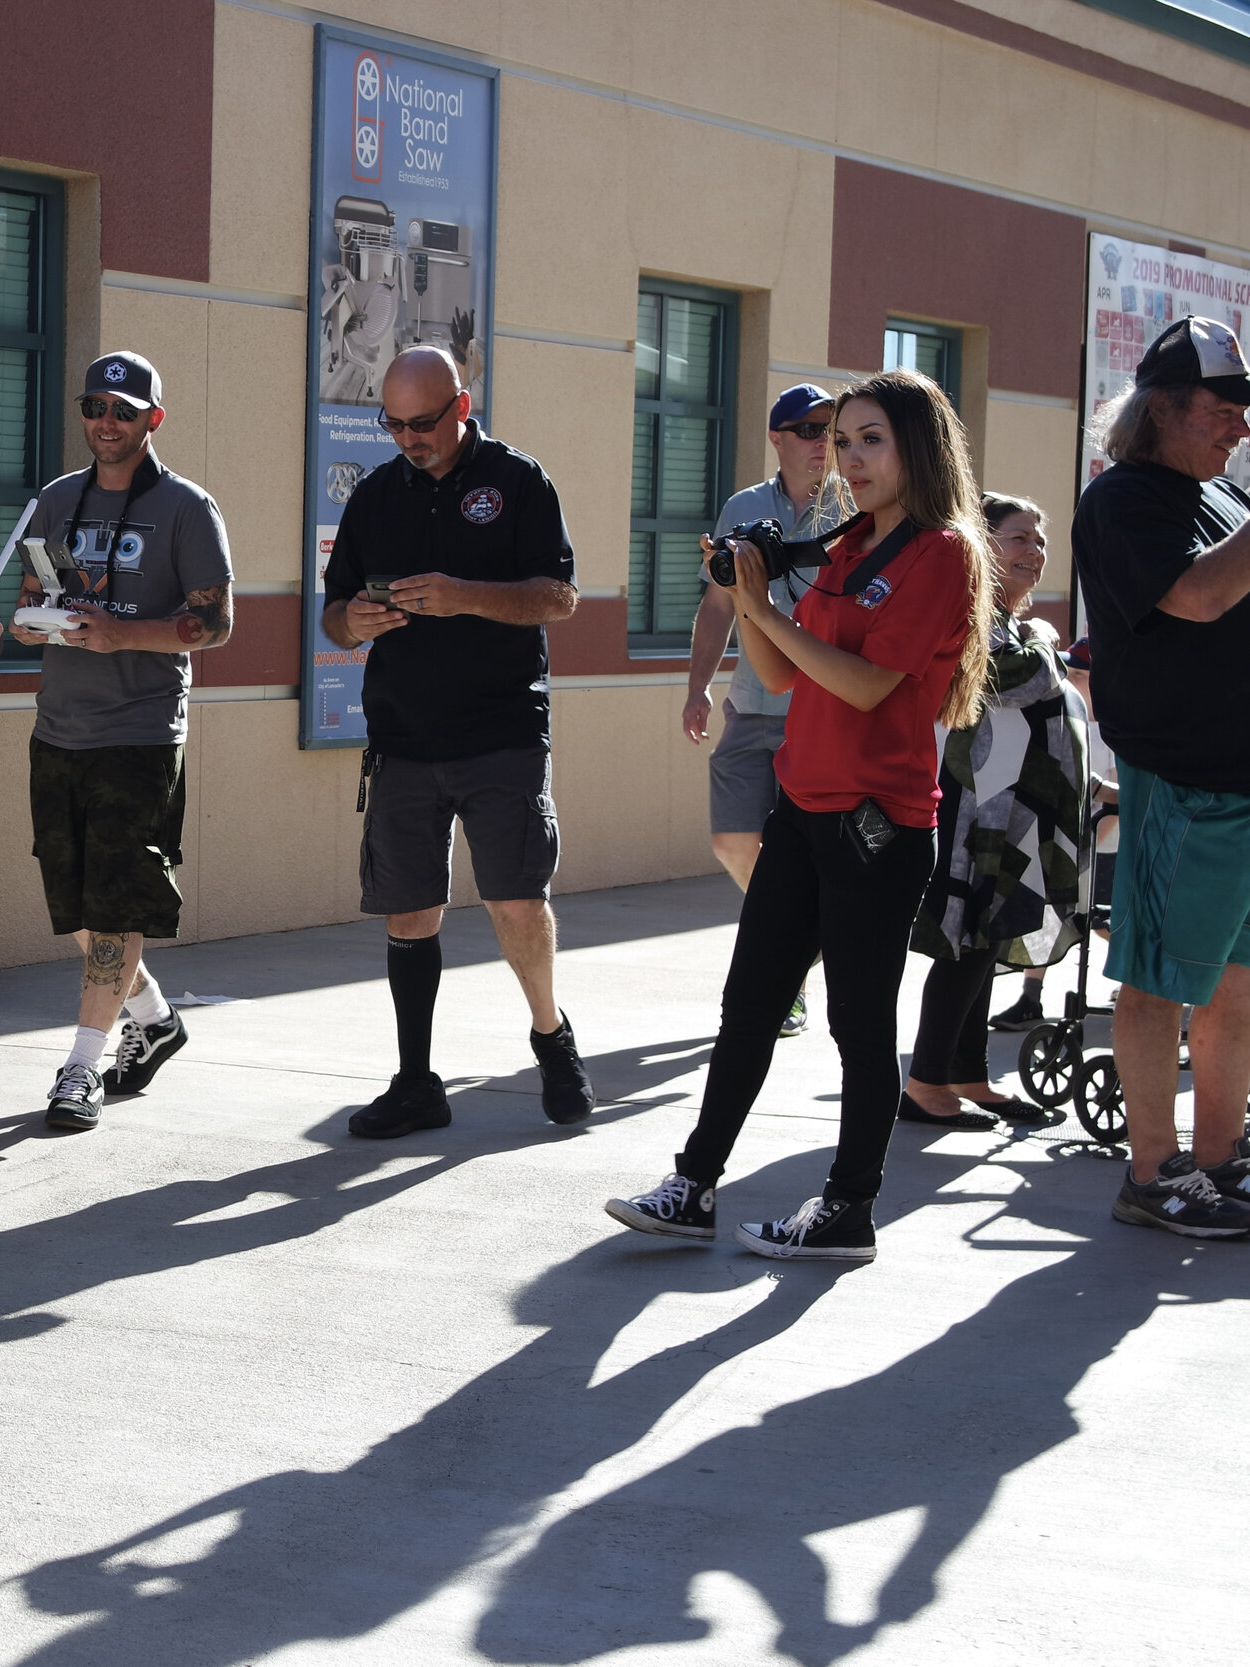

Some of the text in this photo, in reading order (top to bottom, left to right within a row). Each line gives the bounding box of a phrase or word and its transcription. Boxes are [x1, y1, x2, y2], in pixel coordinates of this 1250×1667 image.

[386, 73, 463, 117] National
[400, 108, 448, 145] Band
[405, 138, 443, 171] Saw
[1133, 259, 1160, 283] 2019
[1163, 262, 1233, 302] PROMOTIONAL
[1096, 286, 1111, 301] APR
[1179, 299, 1191, 313] JUN
[334, 414, 372, 428] Equipment,
[330, 430, 375, 443] Refrigeration,
[314, 648, 368, 666] www.Na
